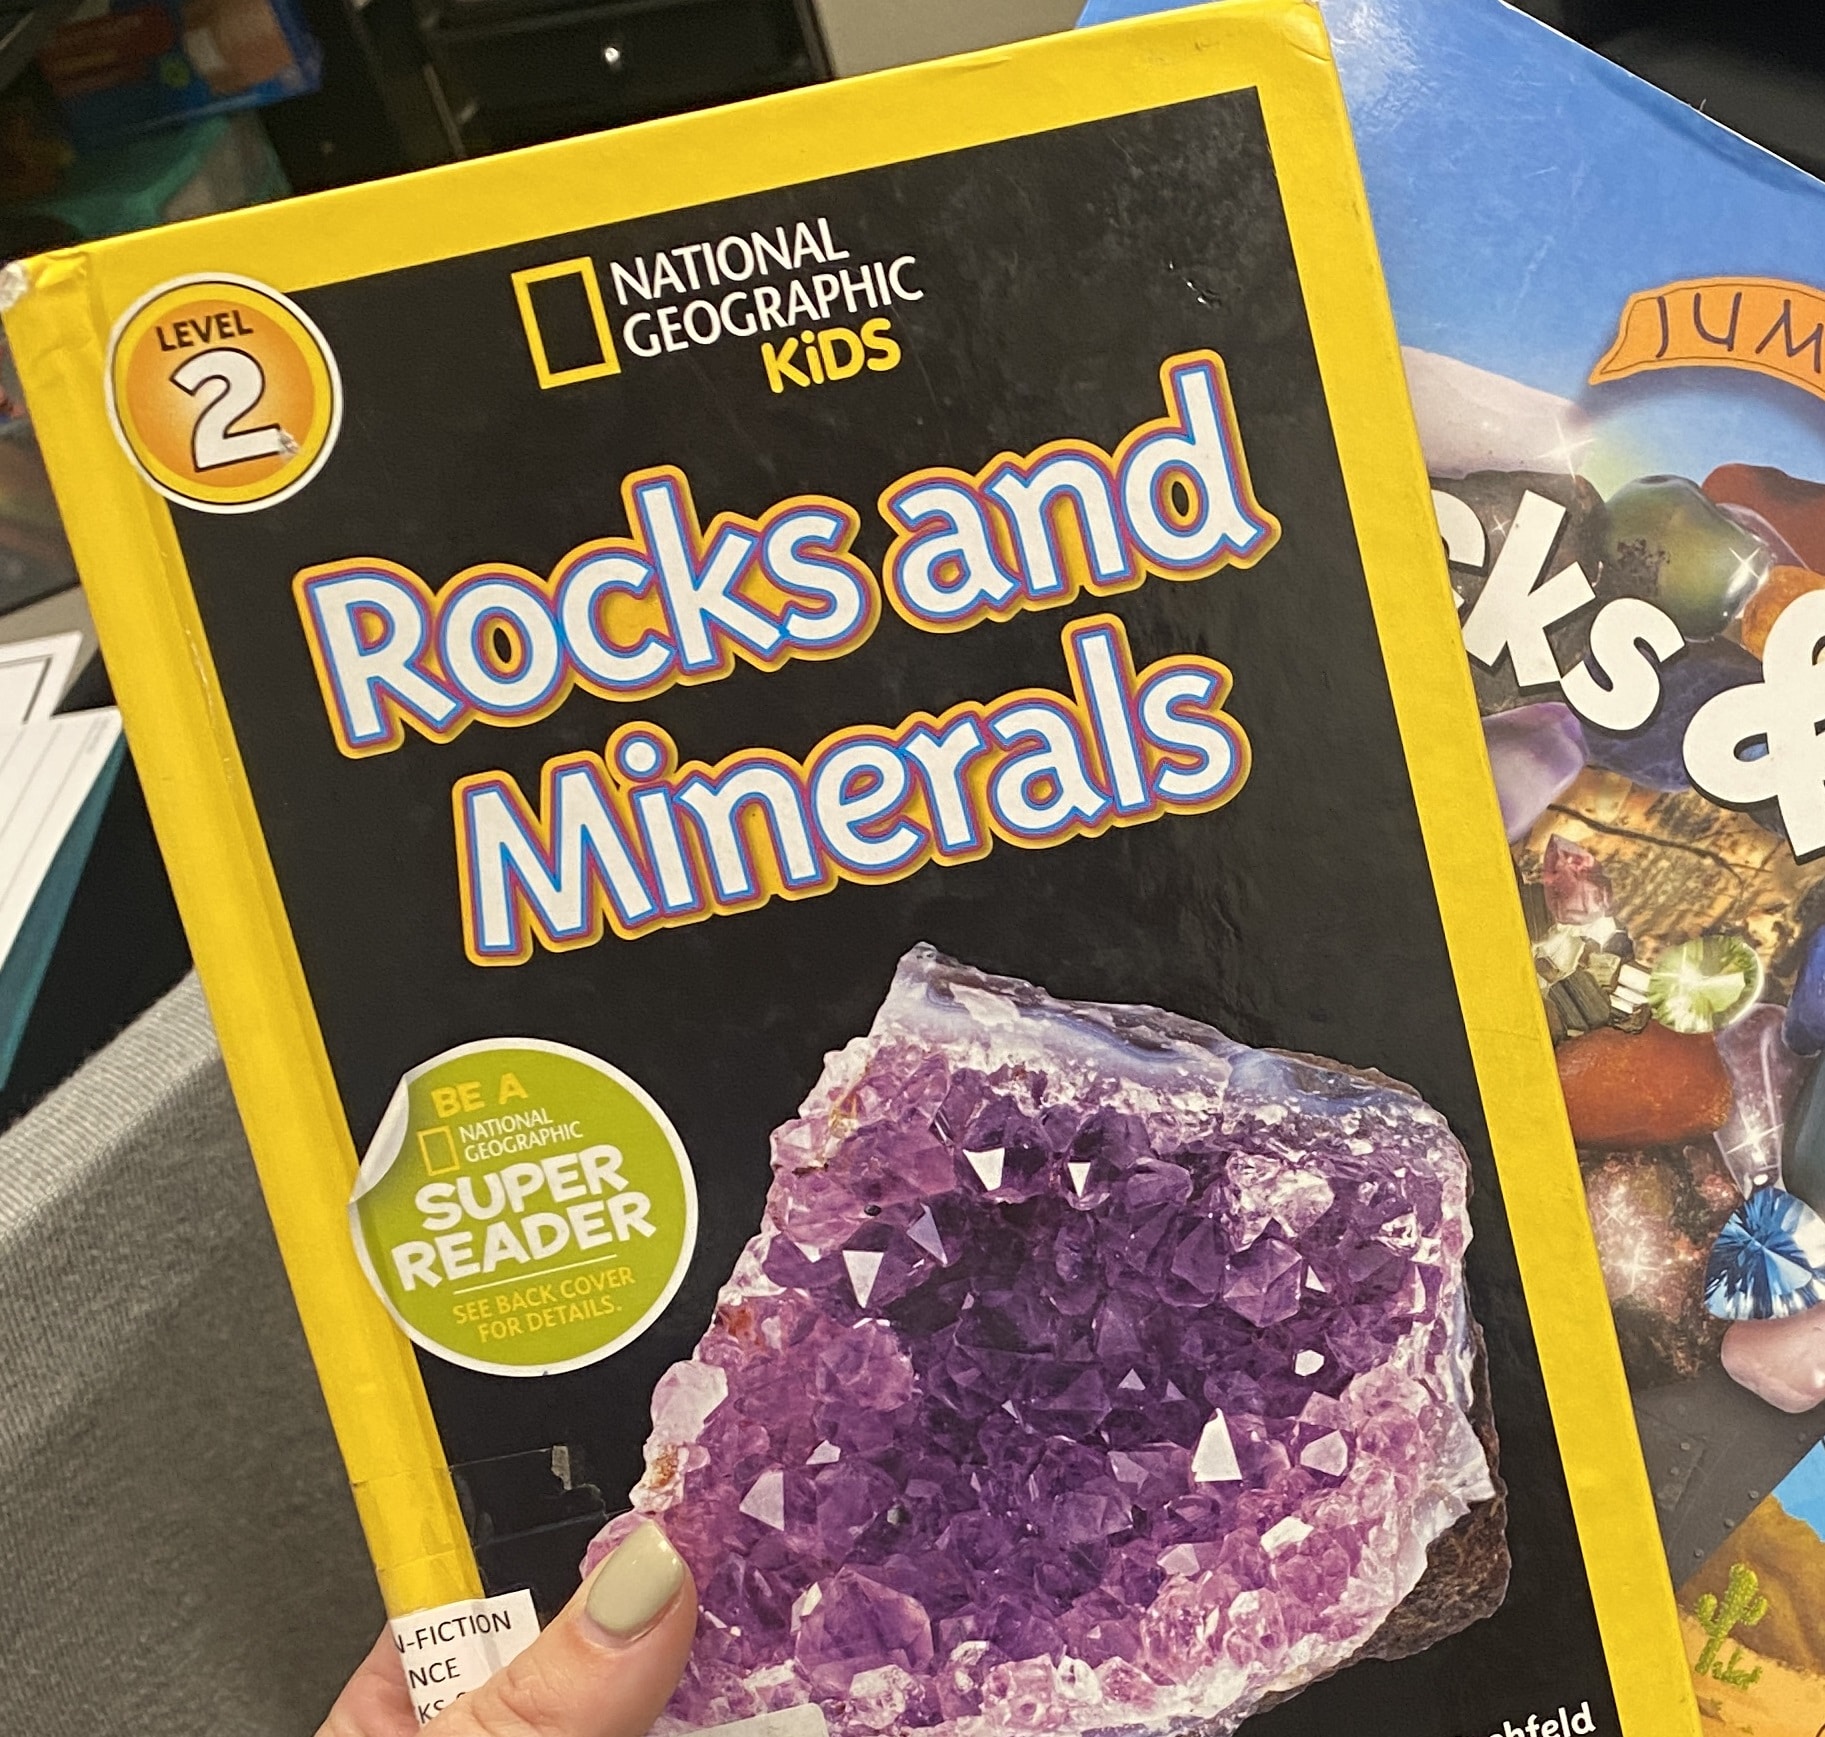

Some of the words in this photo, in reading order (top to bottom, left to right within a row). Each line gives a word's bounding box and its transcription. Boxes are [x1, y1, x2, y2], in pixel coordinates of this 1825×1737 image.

[610, 217, 850, 306] NATIONAL
[156, 310, 254, 352] LEVEL
[623, 256, 924, 358] GEOGRAPHIC
[169, 346, 290, 472] 2
[301, 473, 873, 748] Rocks
[887, 358, 1272, 624] and
[459, 623, 1244, 957] Minerals
[430, 1081, 486, 1119] BE
[498, 1072, 529, 1105] A
[459, 1107, 554, 1144] NATIONAL
[465, 1121, 583, 1164] GEOGRAPHIC
[414, 1144, 630, 1231] SUPER
[391, 1191, 658, 1292] READER
[452, 1300, 493, 1325] SEE
[498, 1285, 556, 1315] BACK
[560, 1266, 637, 1299] COVER
[477, 1316, 523, 1344] FOR
[528, 1295, 623, 1332] DETAILS.
[408, 1657, 461, 1689] NCE
[1489, 1700, 1597, 1737] hfeld
